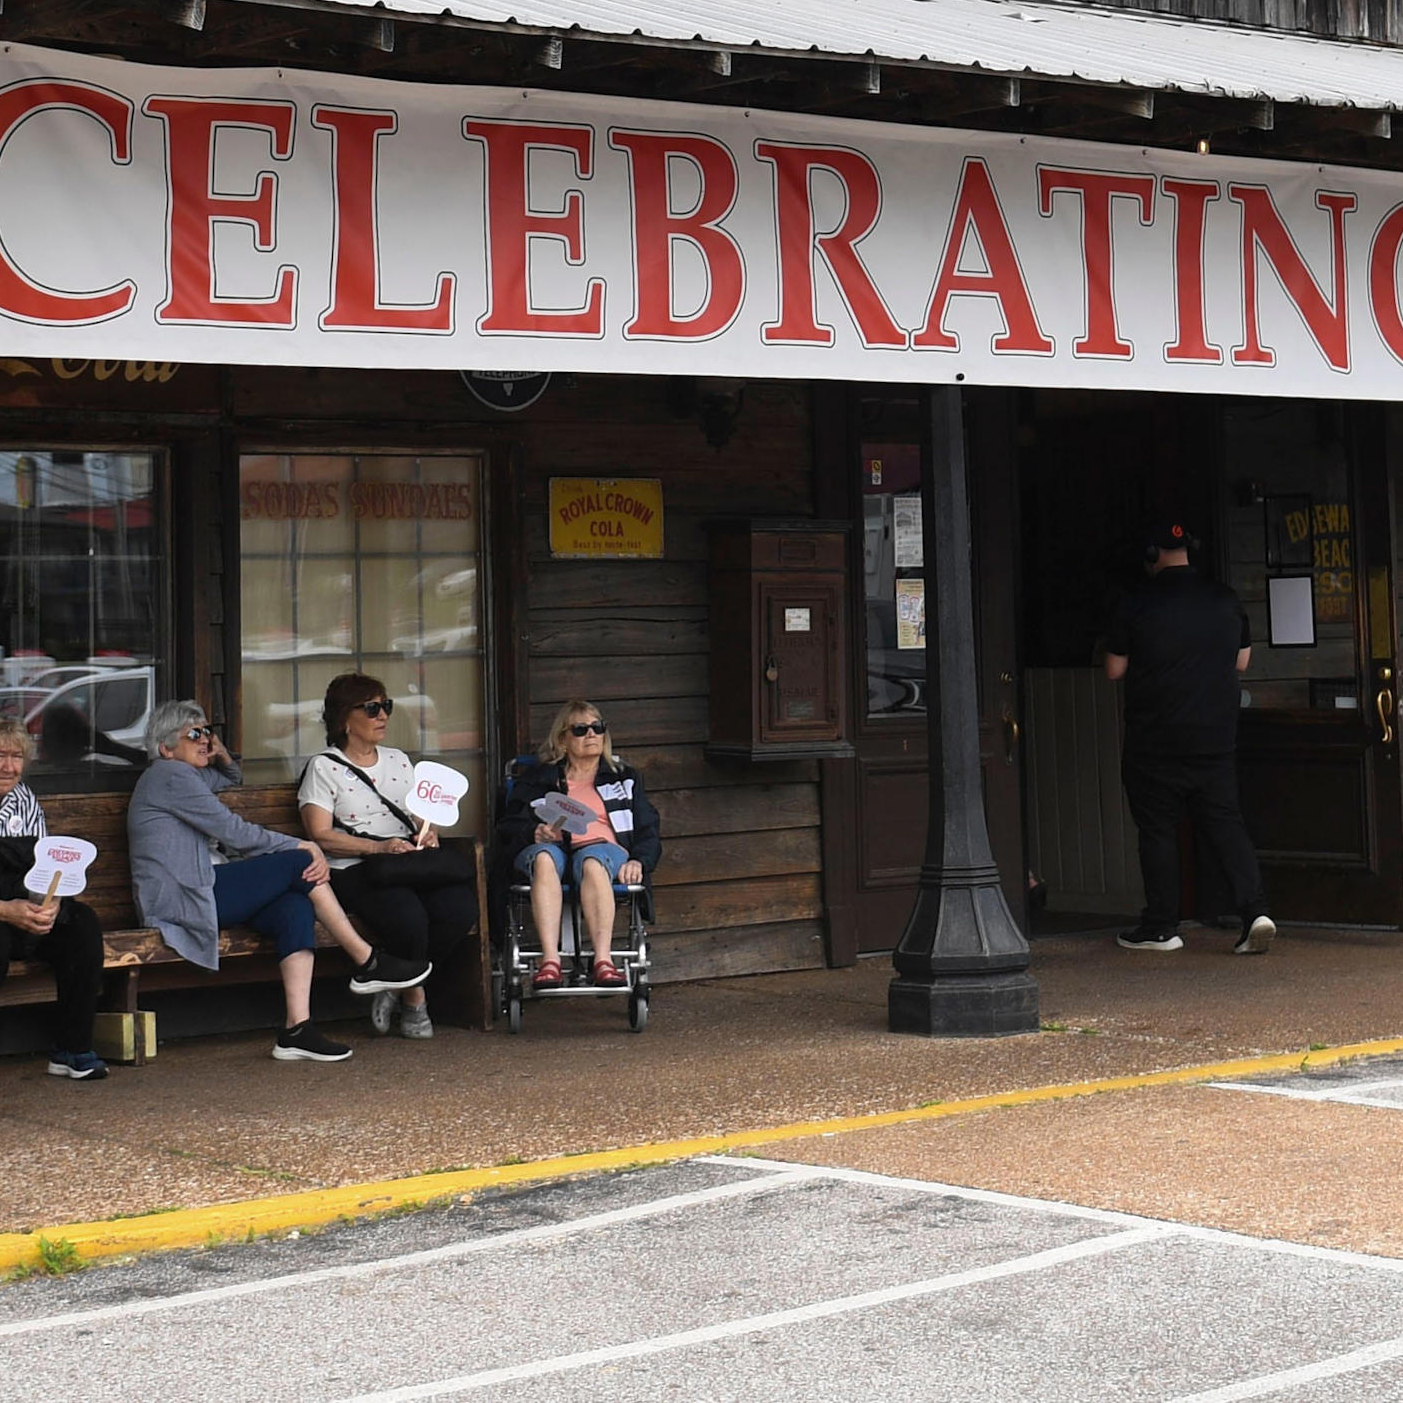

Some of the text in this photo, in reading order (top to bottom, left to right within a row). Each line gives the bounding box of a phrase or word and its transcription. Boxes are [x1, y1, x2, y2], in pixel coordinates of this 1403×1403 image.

[242, 479, 340, 520] SODAS
[559, 492, 654, 526] ROYAL CROWN
[590, 520, 624, 537] COLA
